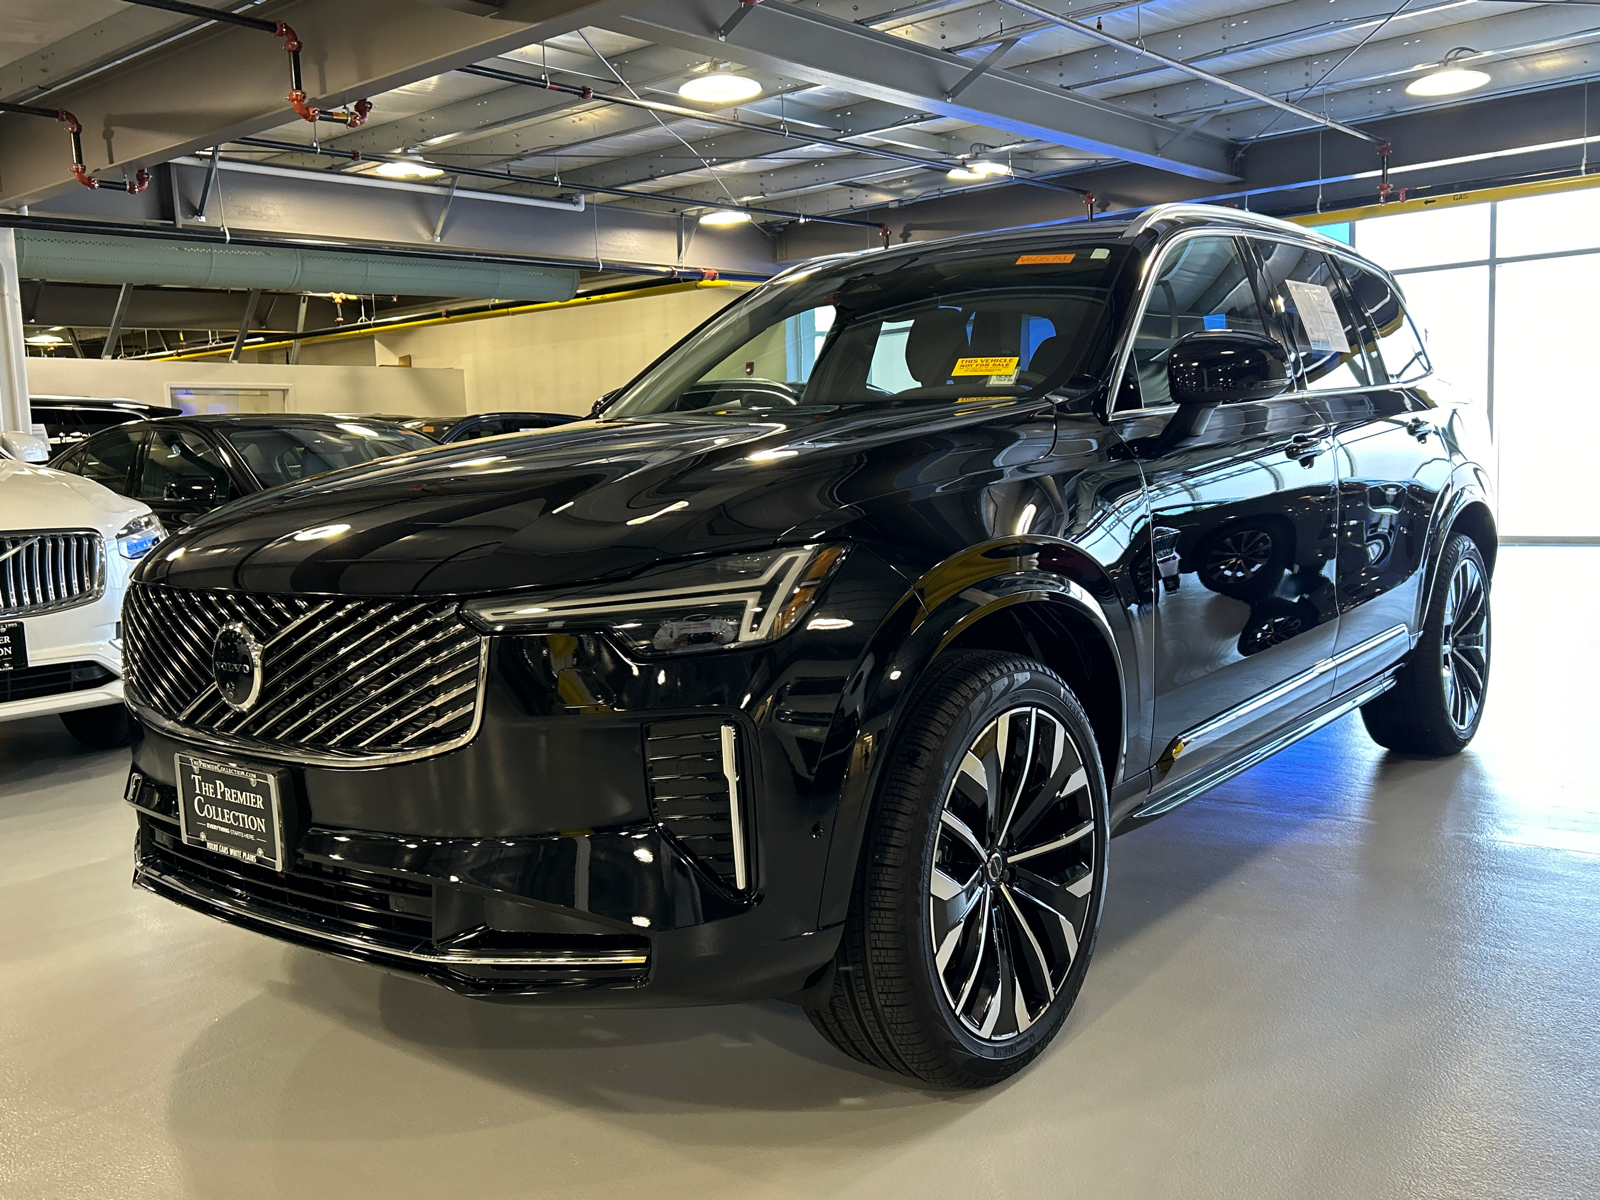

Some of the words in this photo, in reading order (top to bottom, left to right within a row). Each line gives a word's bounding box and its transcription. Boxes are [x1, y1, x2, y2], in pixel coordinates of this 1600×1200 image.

[1453, 193, 1468, 201] GAS
[215, 660, 250, 674] VOLVO
[191, 774, 216, 799] THE
[215, 780, 265, 810] PREMIER
[194, 796, 266, 834] COLLECTION
